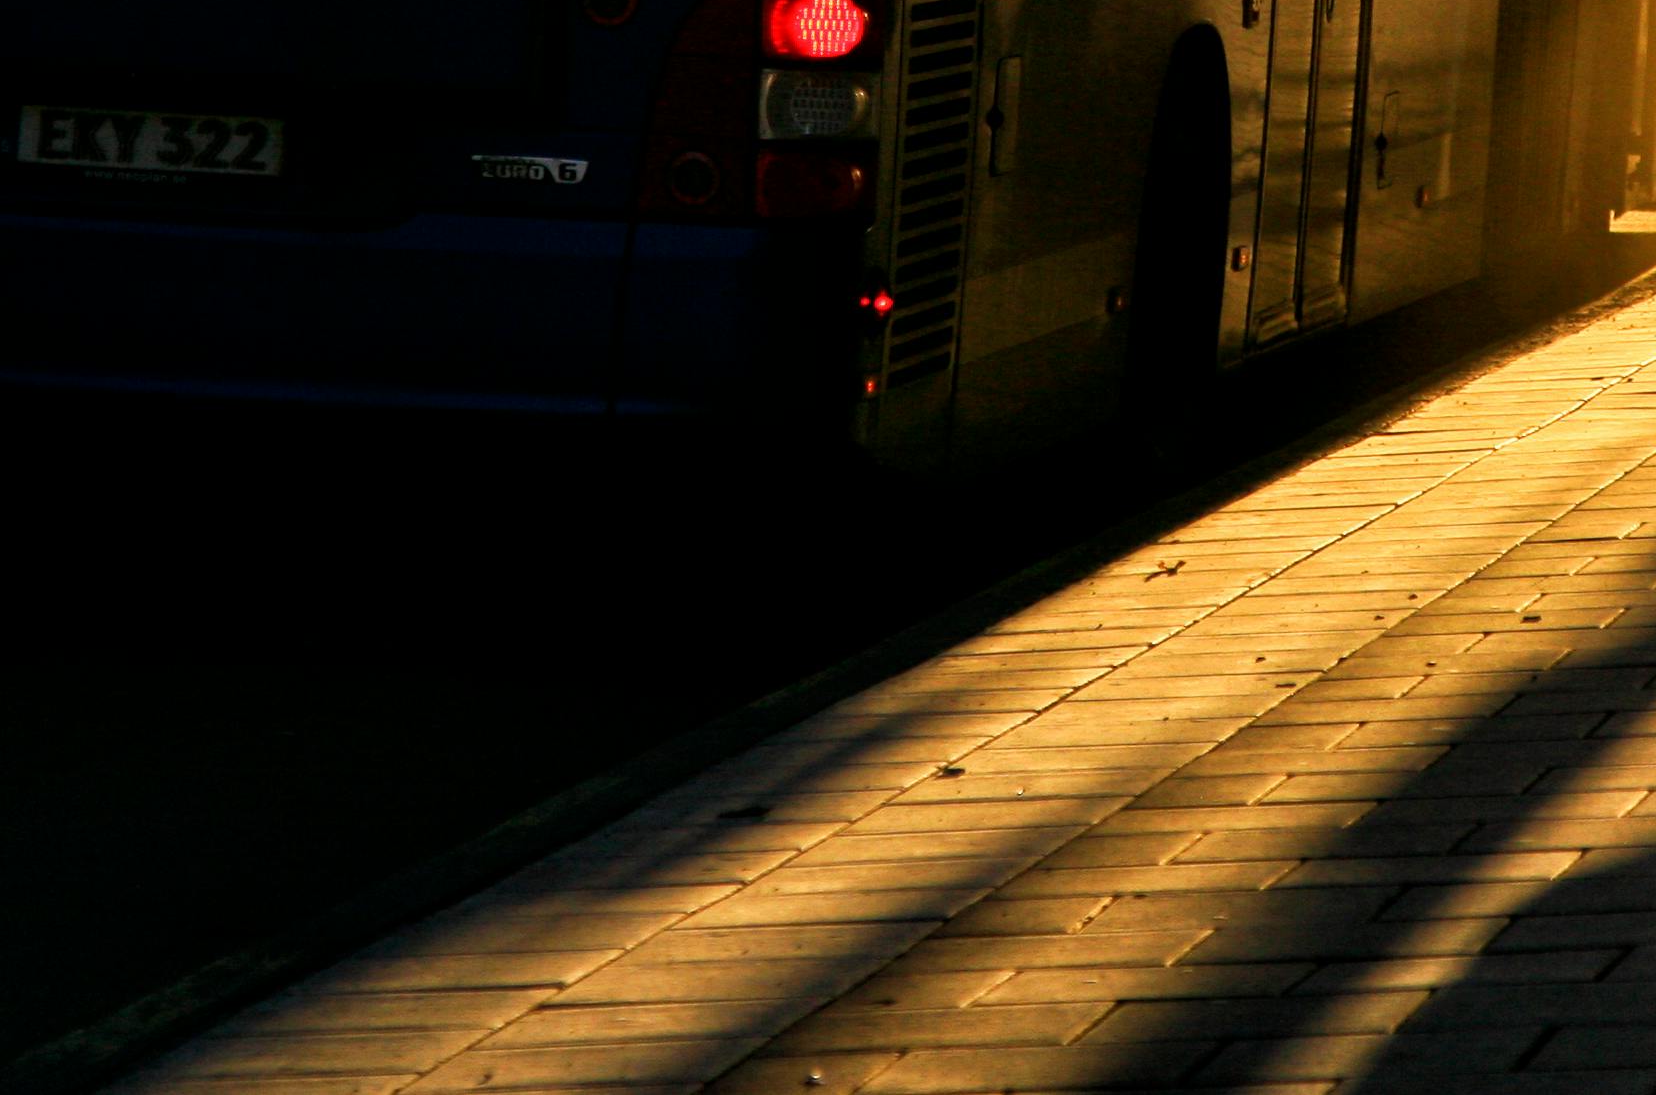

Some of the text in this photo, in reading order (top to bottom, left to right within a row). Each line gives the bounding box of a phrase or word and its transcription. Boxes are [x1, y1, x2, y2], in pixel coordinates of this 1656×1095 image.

[38, 109, 270, 171] EKY 322
[480, 162, 546, 181] EURO
